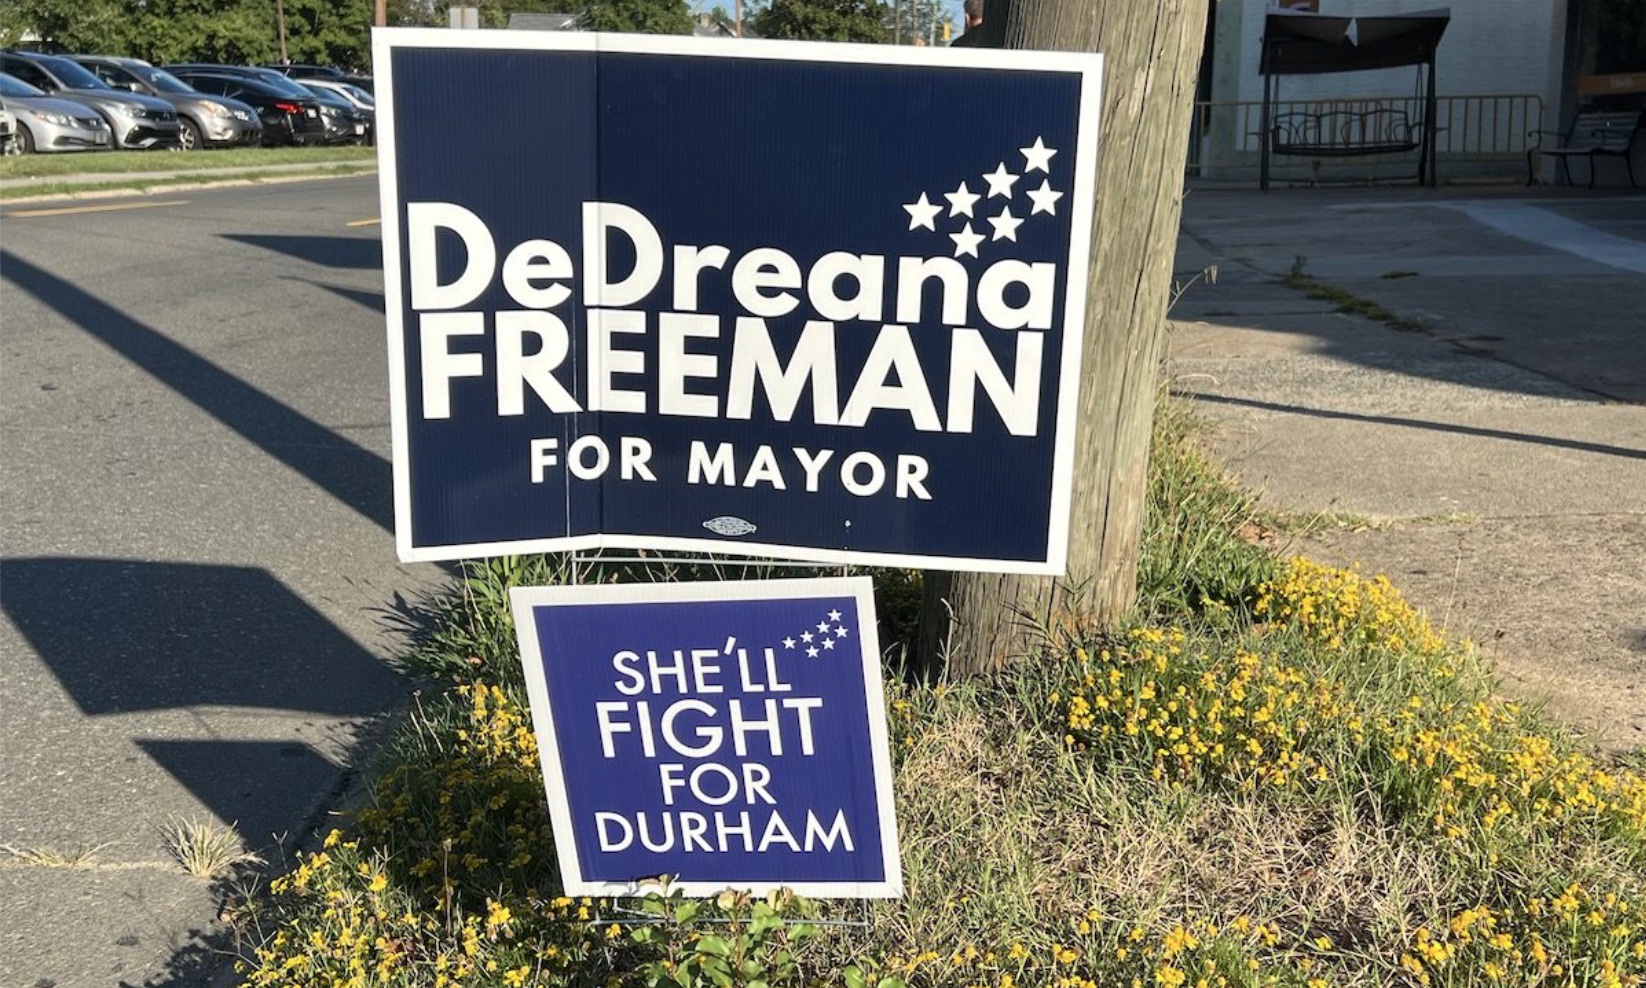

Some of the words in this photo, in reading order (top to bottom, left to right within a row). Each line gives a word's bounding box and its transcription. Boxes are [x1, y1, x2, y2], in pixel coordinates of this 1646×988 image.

[407, 202, 1055, 329] DeDreana
[420, 309, 1043, 436] FREEMAN
[531, 435, 657, 486] FOR
[688, 441, 932, 499] MAYOR
[613, 637, 791, 695] SHE'LL
[596, 698, 822, 758] FIGHT
[660, 763, 777, 805] FOR
[595, 809, 854, 852] DURHAM
